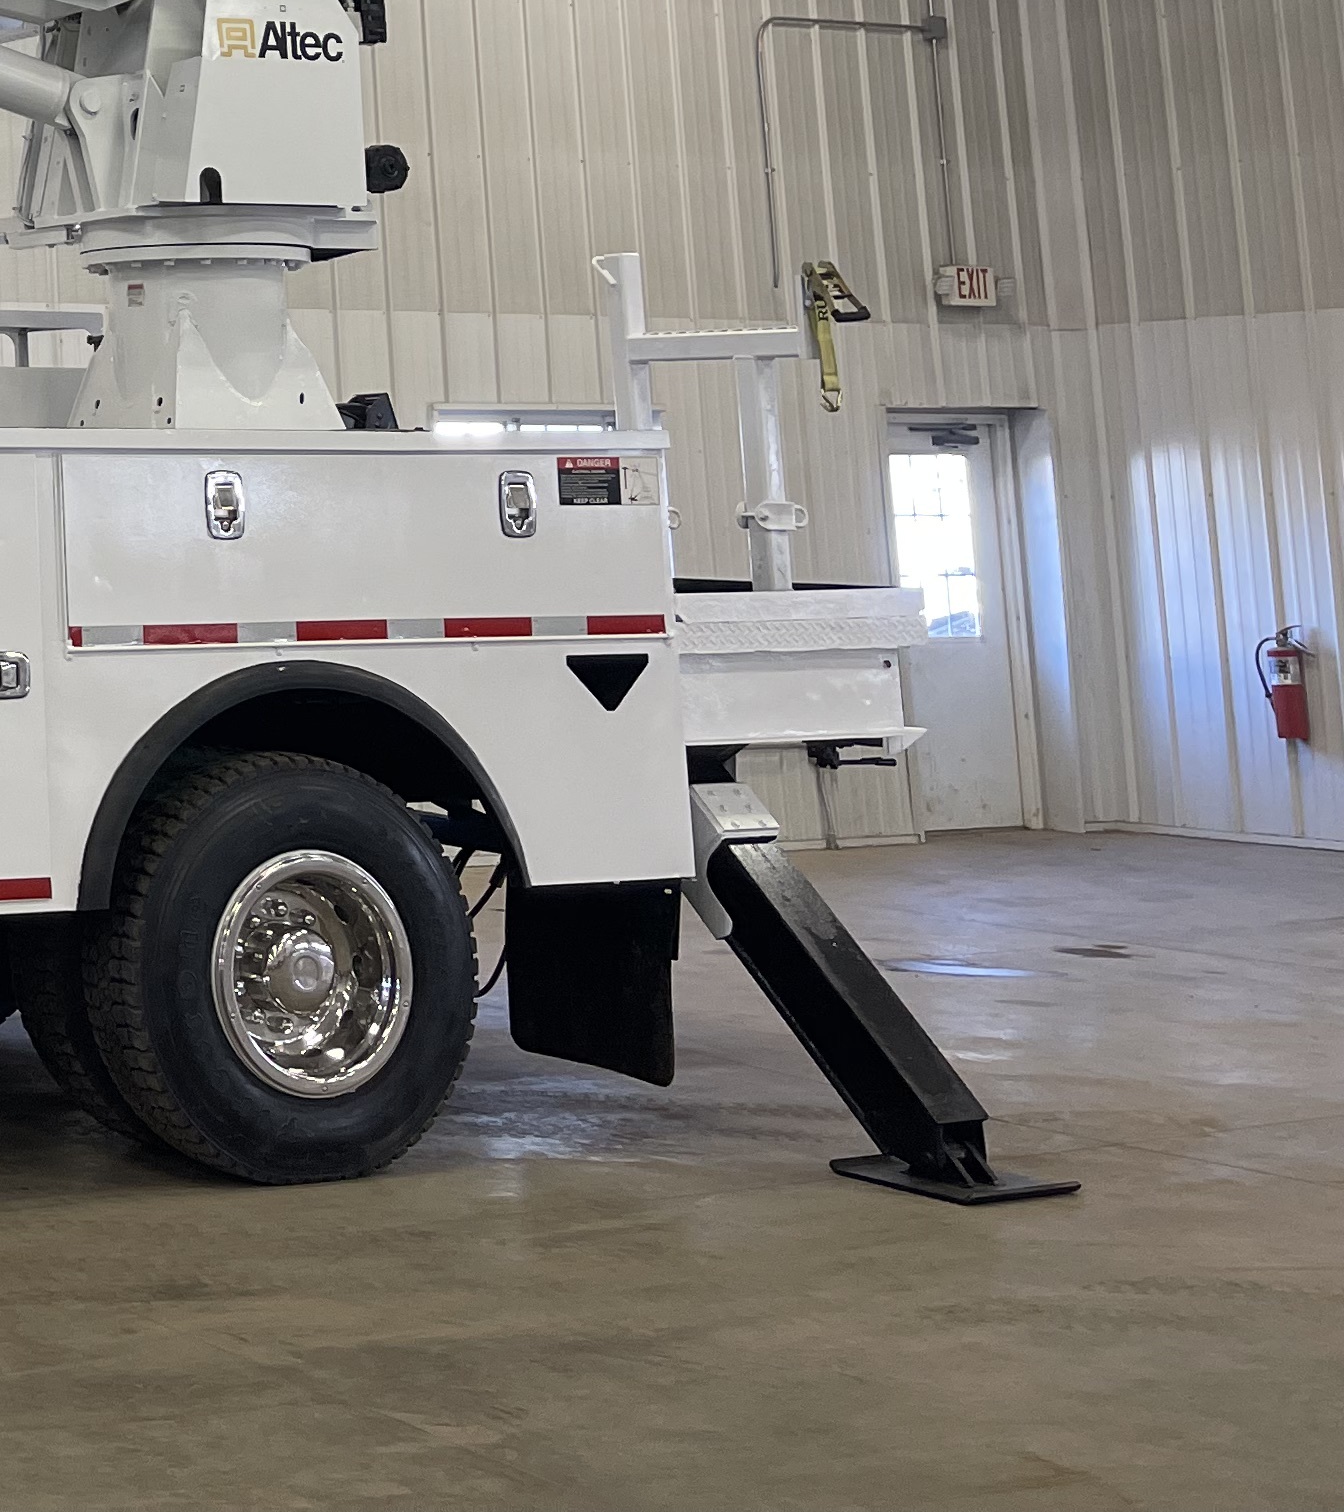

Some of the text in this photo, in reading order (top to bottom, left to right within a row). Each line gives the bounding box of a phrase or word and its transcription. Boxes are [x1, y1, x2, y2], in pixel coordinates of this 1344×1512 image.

[258, 21, 344, 62] Altec
[956, 267, 988, 299] EXIT
[576, 459, 611, 467] DANGER
